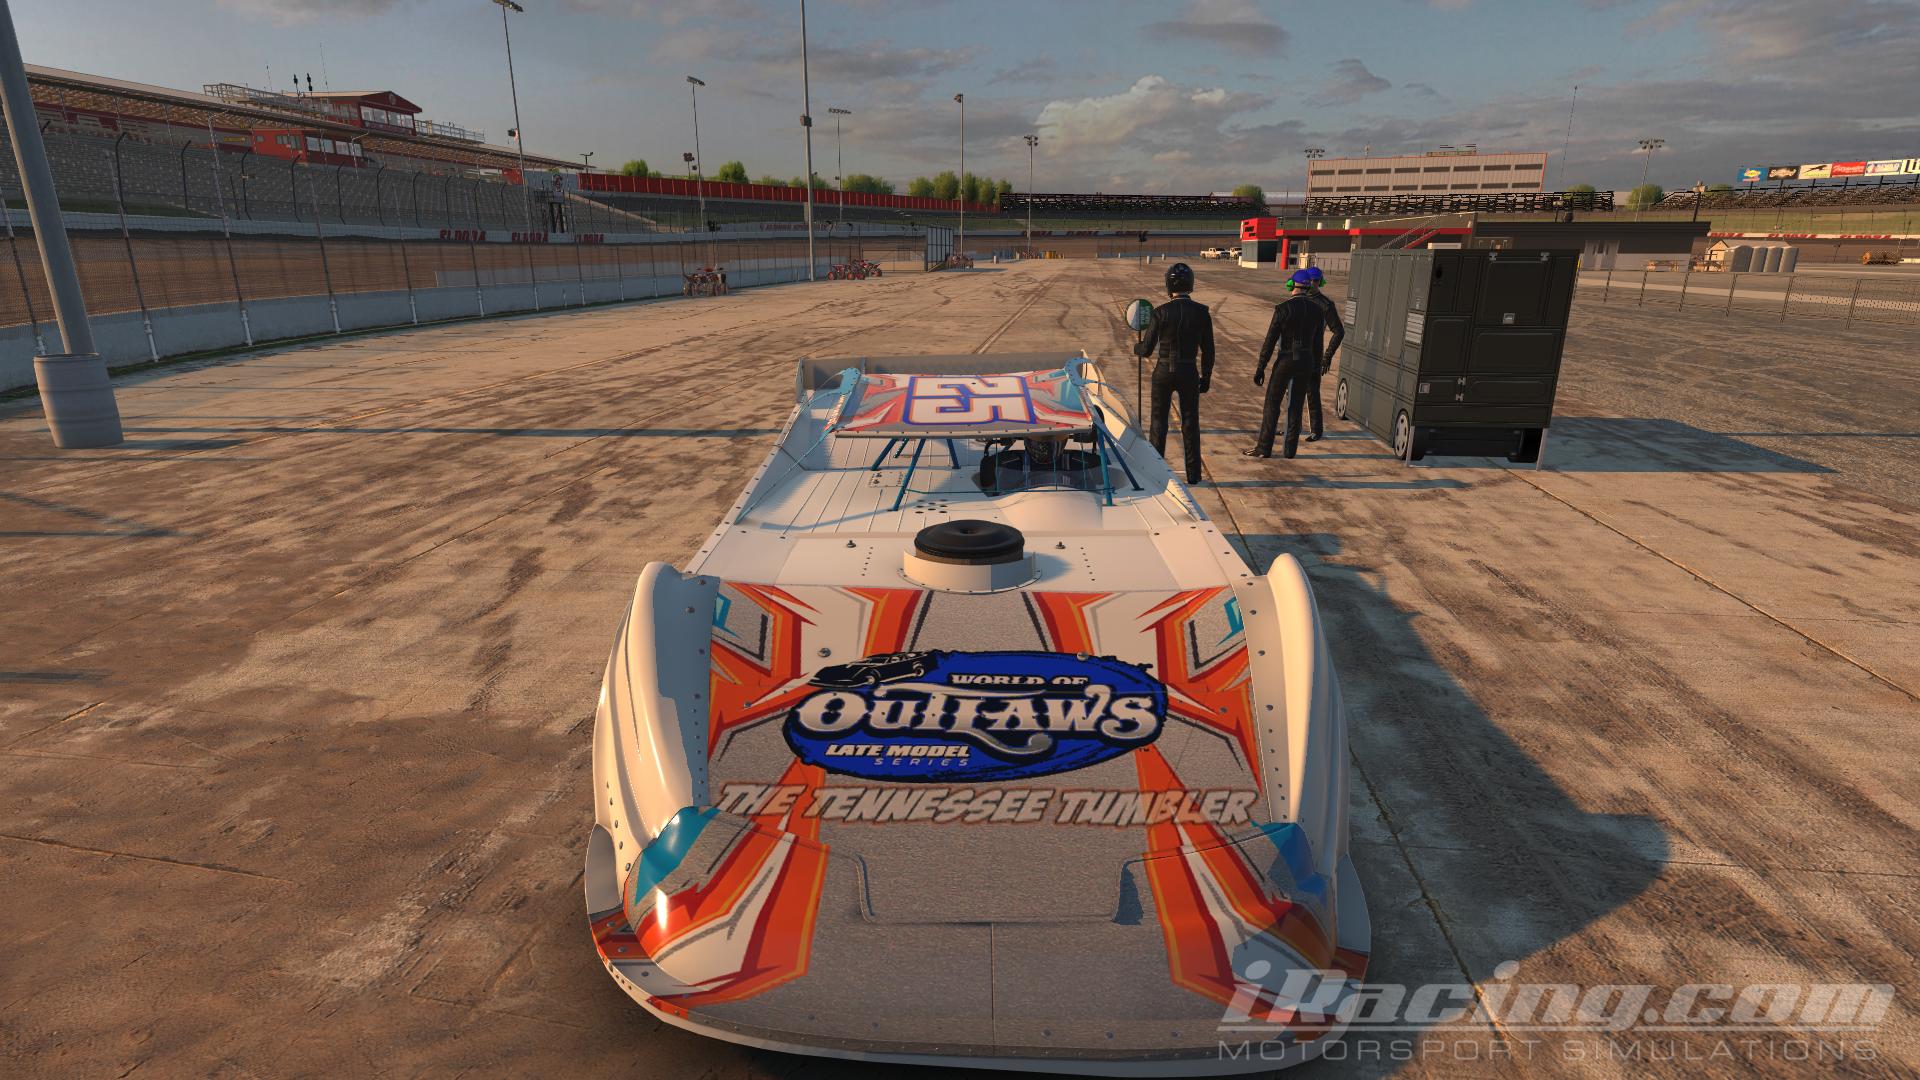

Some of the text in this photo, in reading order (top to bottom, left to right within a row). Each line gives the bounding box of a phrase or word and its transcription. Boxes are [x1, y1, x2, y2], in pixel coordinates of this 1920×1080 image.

[950, 674, 1090, 686] WORLD OF
[825, 744, 971, 758] LATE MODEL
[874, 757, 970, 766] SERIES
[714, 783, 1259, 826] THE TENNESSEE TUMBLER
